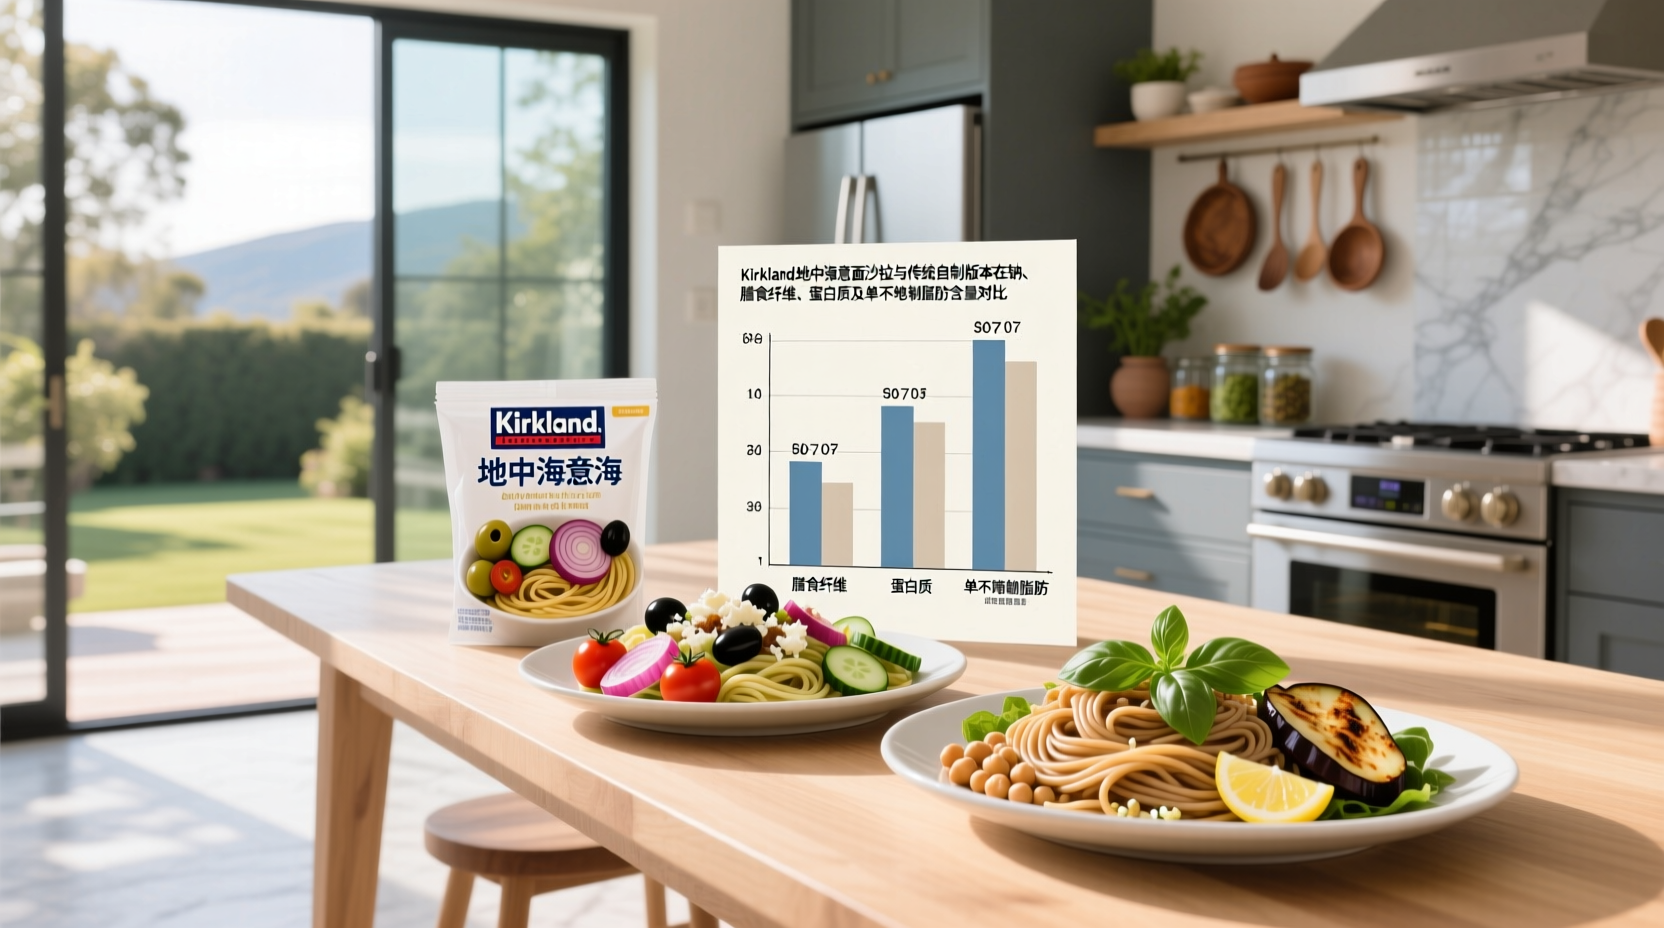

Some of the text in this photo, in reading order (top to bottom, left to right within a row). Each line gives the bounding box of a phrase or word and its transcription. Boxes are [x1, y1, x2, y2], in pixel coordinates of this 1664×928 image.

[748, 387, 762, 400] 10
[477, 455, 623, 487] 地中海意海
[890, 578, 933, 595] 蛋白质
